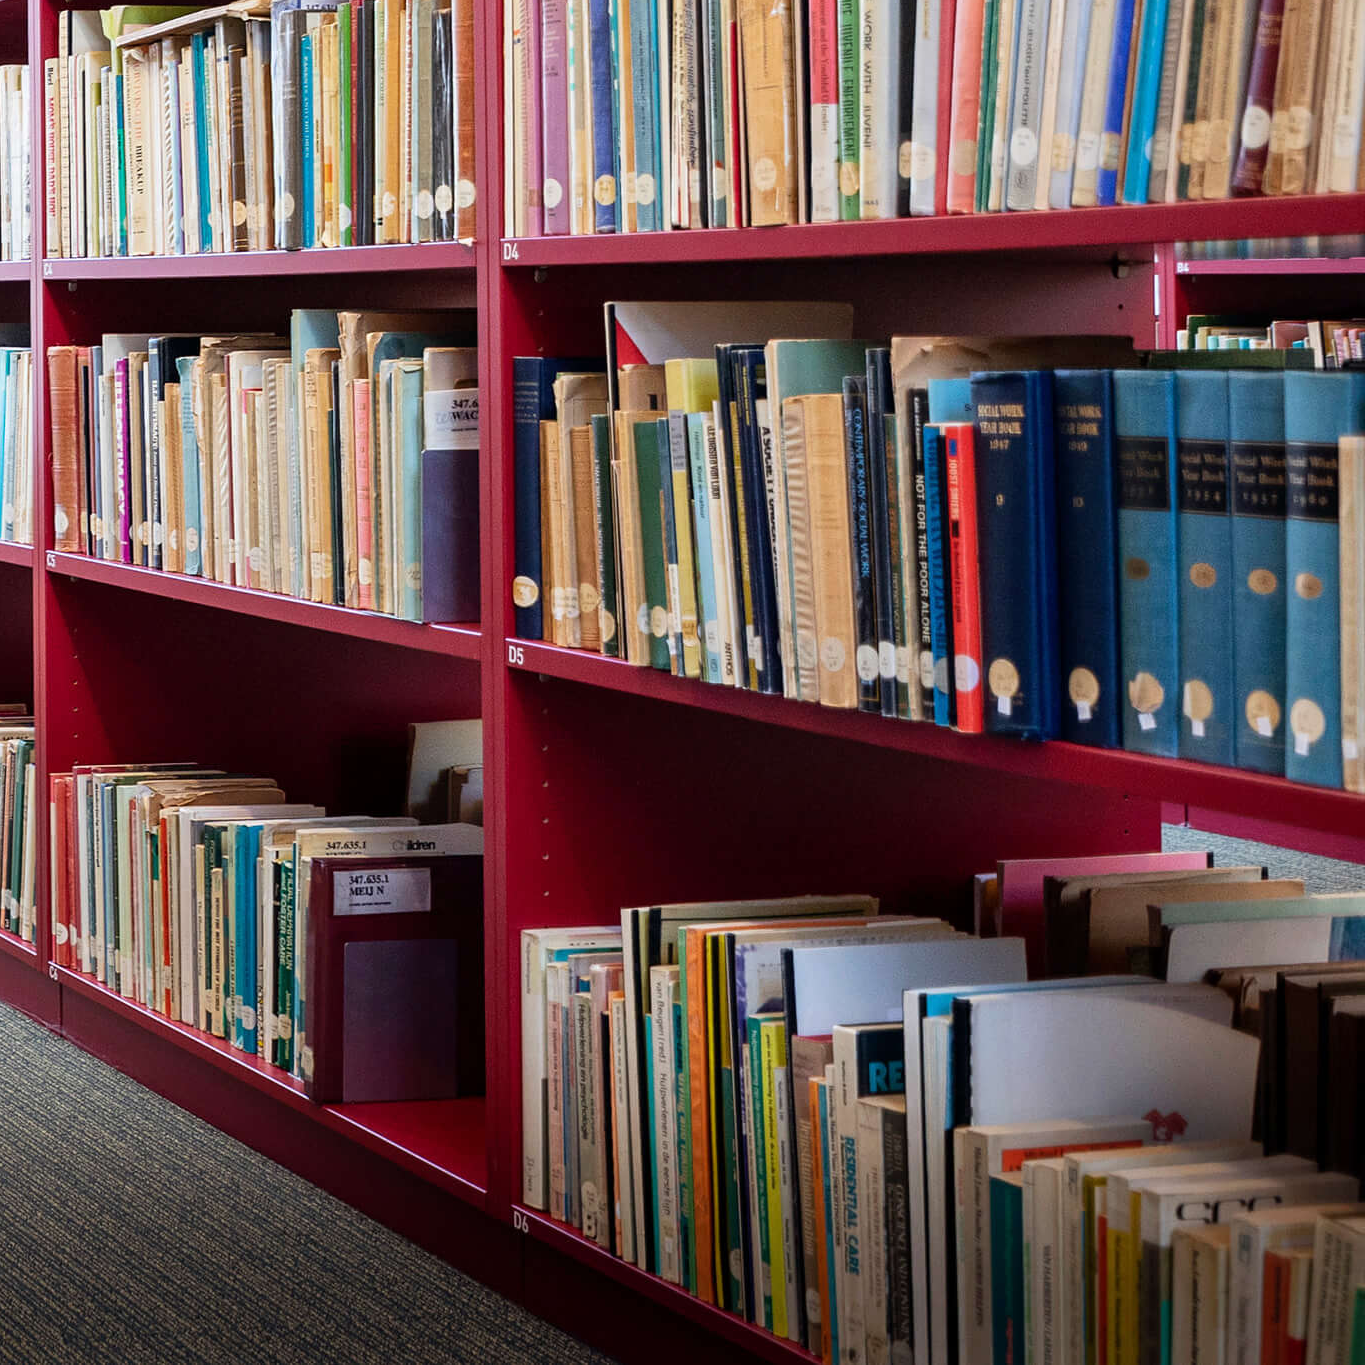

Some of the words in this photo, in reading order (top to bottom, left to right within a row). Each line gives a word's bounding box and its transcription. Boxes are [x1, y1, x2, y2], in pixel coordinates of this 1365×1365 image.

[820, 29, 828, 41] and
[864, 10, 873, 51] WORK
[820, 44, 829, 56] the
[842, 24, 854, 72] JUVENILE
[820, 58, 829, 95] Youthful
[864, 60, 873, 94] WITH
[843, 79, 856, 158] ENFORCEMENT
[135, 145, 144, 195] BREAKUP
[503, 242, 518, 260] D4
[977, 404, 999, 417] SOCIAL
[1000, 404, 1025, 417] WORK
[980, 421, 997, 434] YEAR
[998, 421, 1022, 434] BOOK
[854, 408, 866, 499] CONTEMPORARY
[915, 474, 925, 500] NOT
[948, 459, 958, 485] JOOST
[698, 484, 704, 493] en
[858, 502, 867, 540] SOCIAL
[917, 504, 926, 529] FOR
[860, 543, 869, 577] WORK
[918, 534, 927, 557] THE
[919, 562, 929, 598] POOR
[920, 603, 931, 643] ALONE
[508, 644, 523, 665] D5
[725, 642, 733, 676] ANTHOS
[325, 840, 367, 851] 347.635.1
[348, 875, 389, 886] 347.635.1
[656, 1001, 667, 1036] Beugen
[578, 1003, 589, 1068] Hulpverlening
[580, 1069, 587, 1082] en
[580, 1083, 591, 1139] psychologie
[658, 1073, 669, 1137] Hulpverlenen
[662, 1140, 670, 1150] in
[662, 1151, 671, 1163] de
[663, 1167, 672, 1197] eerste
[845, 1137, 858, 1228] RESIDENTIAL
[513, 1210, 529, 1233] D6
[848, 1235, 860, 1276] CARE
